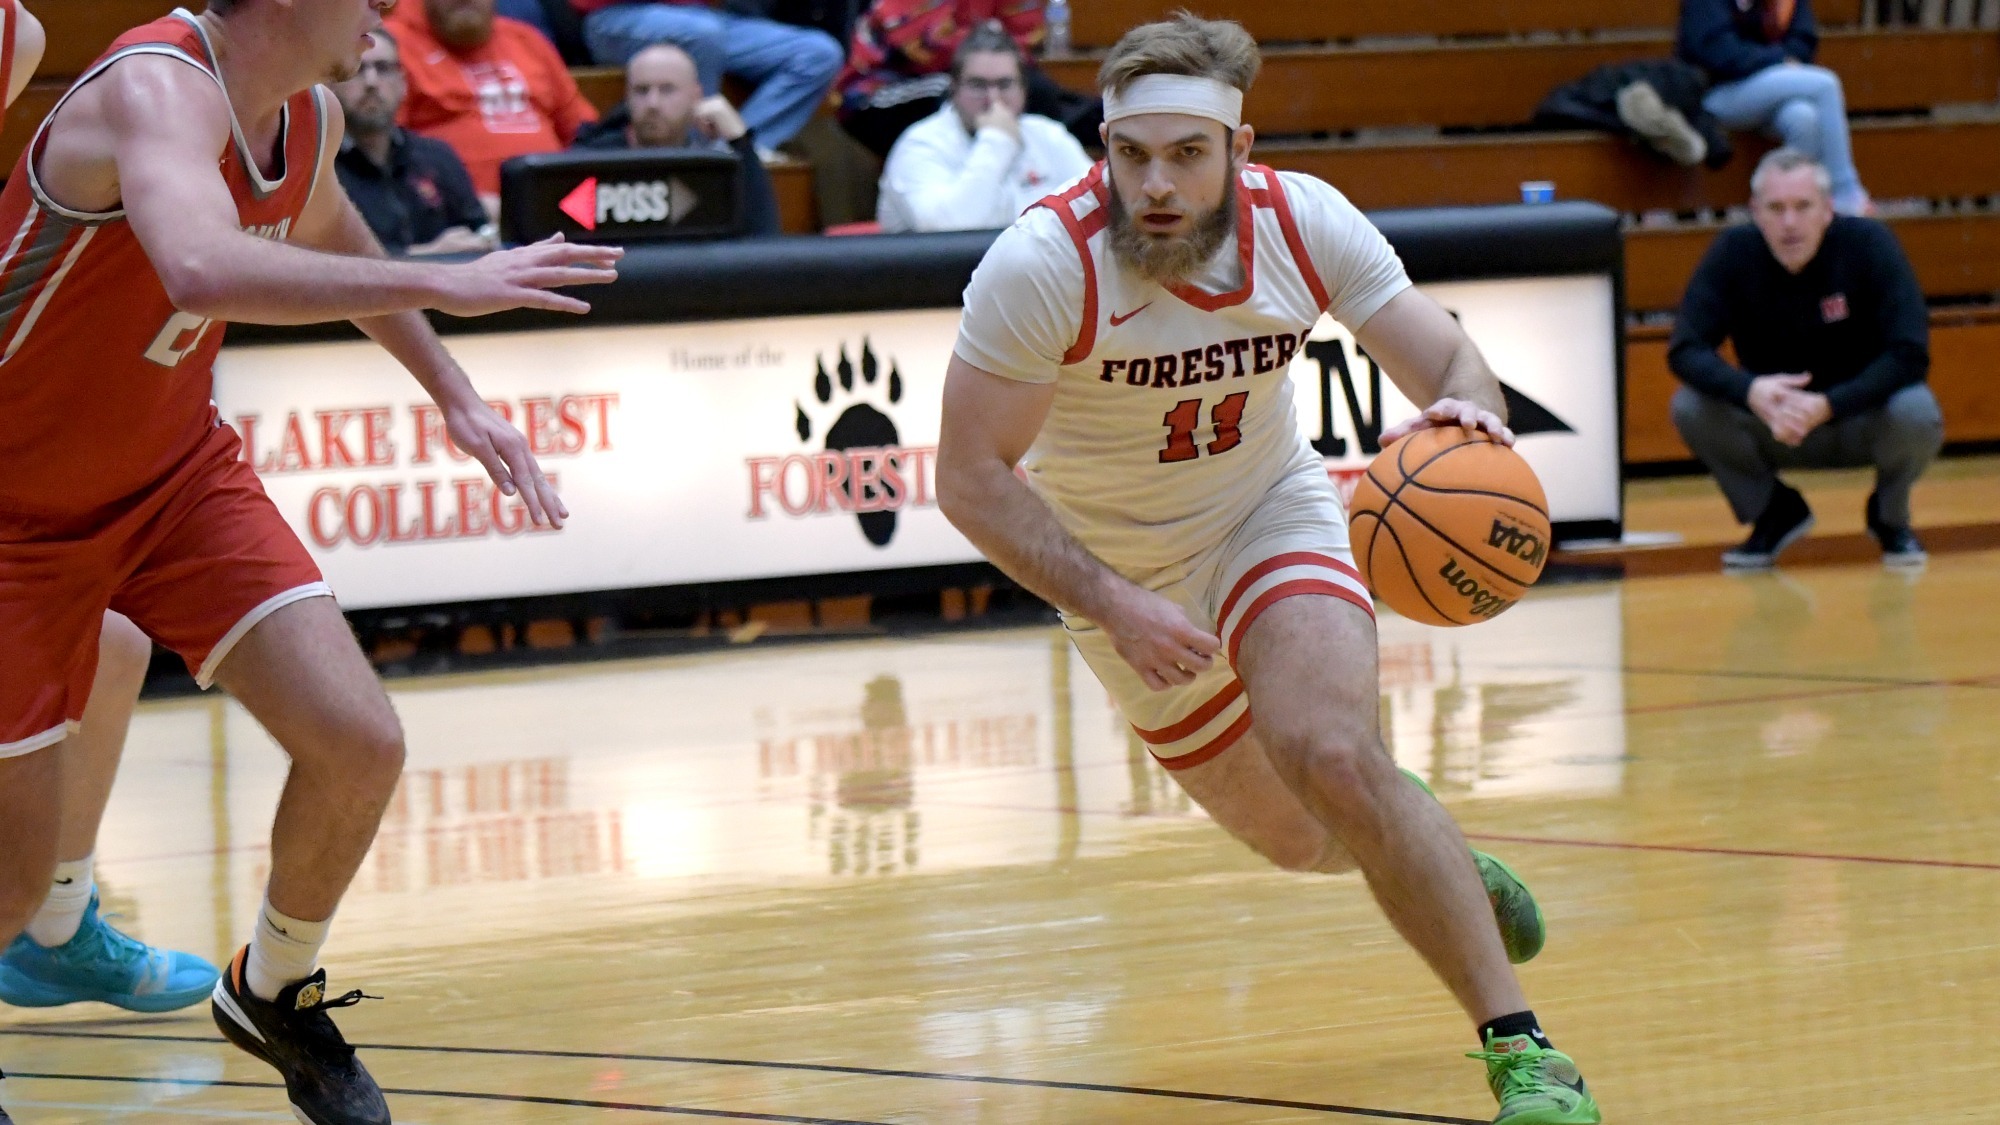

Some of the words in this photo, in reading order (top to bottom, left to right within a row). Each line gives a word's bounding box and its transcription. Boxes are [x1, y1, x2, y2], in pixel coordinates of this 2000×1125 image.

[596, 181, 668, 223] POSS
[670, 350, 726, 371] Home
[733, 348, 751, 367] of
[755, 347, 784, 366] the
[236, 407, 396, 473] LAKE
[1159, 391, 1249, 463] 11
